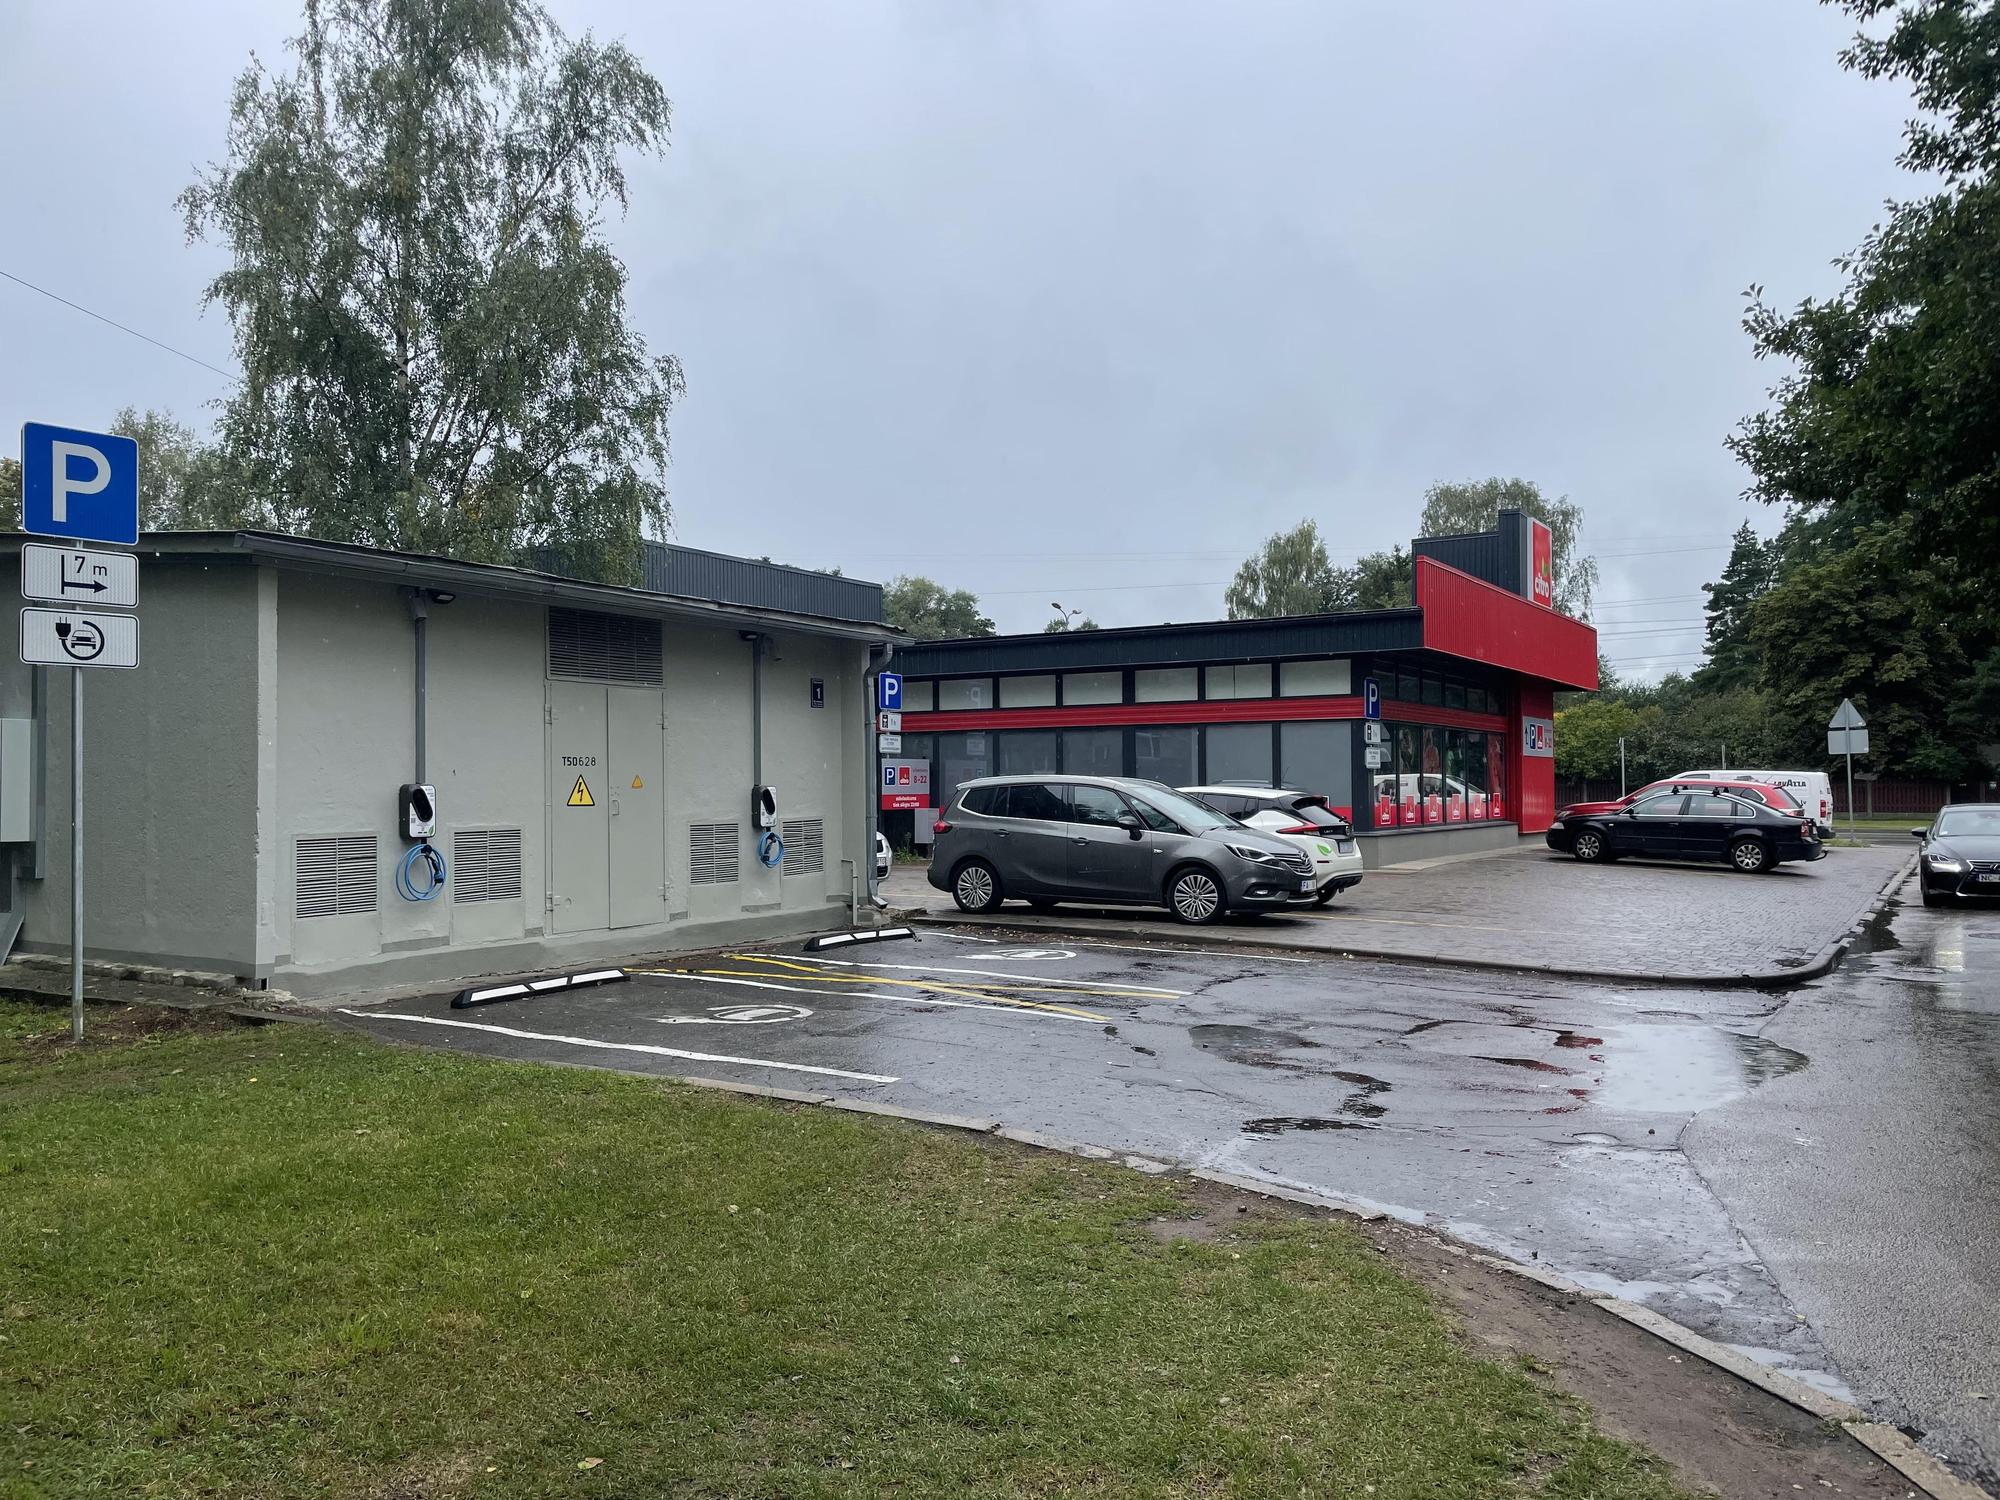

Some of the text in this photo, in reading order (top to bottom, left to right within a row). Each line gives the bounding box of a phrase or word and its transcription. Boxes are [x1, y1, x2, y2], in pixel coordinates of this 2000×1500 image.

[52, 440, 112, 523] P
[75, 556, 108, 577] 7 m
[816, 687, 821, 699] 1
[885, 677, 899, 706] P
[1369, 683, 1378, 714] P
[1530, 726, 1536, 747] P
[886, 768, 895, 784] P
